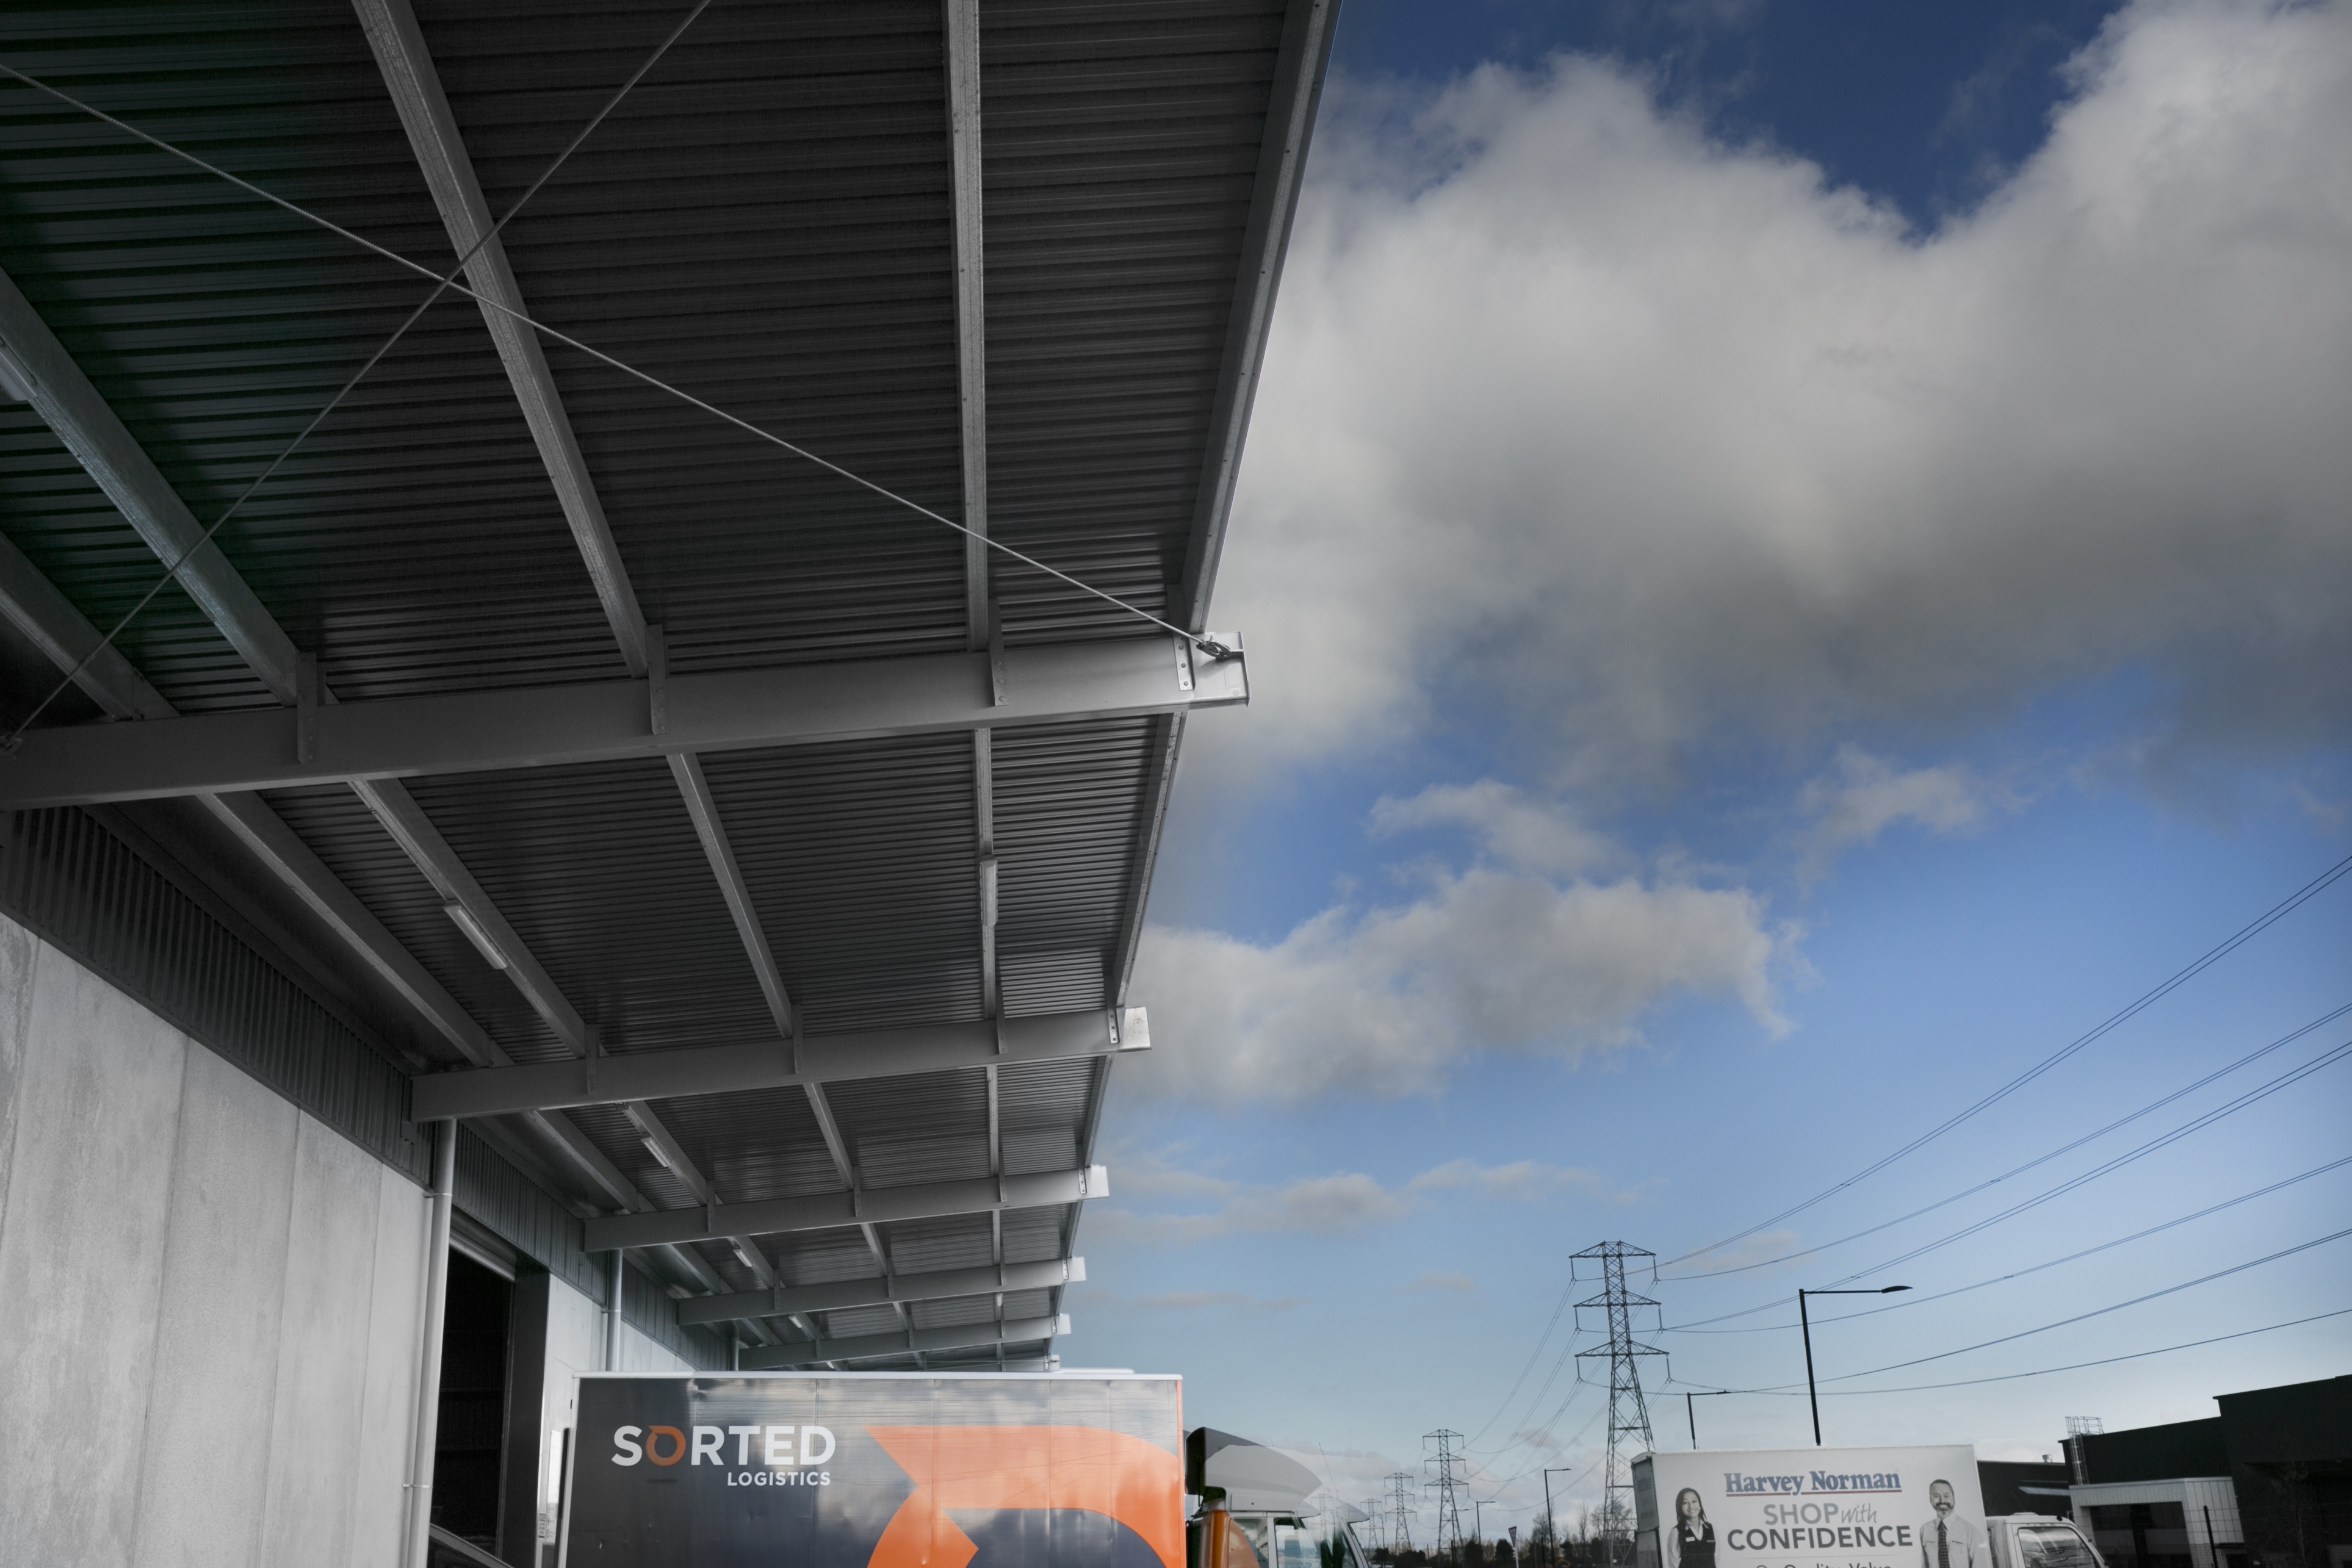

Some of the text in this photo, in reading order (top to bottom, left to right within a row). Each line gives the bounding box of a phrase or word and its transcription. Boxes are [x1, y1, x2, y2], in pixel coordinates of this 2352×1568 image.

[611, 1425, 835, 1466] SORTED
[727, 1472, 831, 1486] LOGISTICS
[1723, 1471, 1901, 1495] Harvey Norman
[1764, 1503, 1877, 1525] SHOP with
[1727, 1525, 1913, 1551] CONFIDENCE
